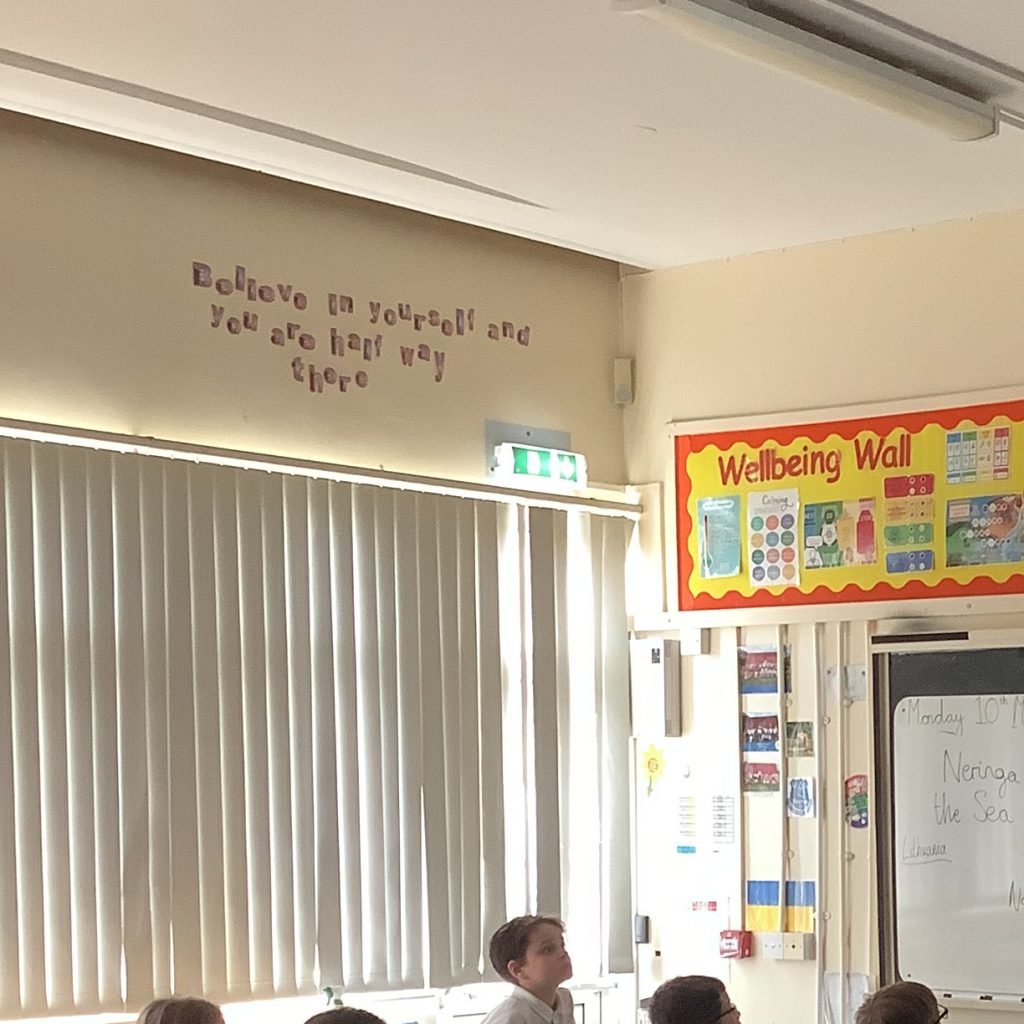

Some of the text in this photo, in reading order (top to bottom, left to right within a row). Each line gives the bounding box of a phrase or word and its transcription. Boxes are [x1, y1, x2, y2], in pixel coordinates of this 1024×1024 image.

[192, 260, 531, 346] Believe in yourself and
[211, 303, 446, 382] you are half way
[291, 356, 369, 393] there
[718, 433, 911, 486] Wellbeing Wall
[907, 698, 965, 737] Monday
[943, 749, 1020, 799] Neringa
[934, 792, 962, 825] the
[973, 789, 1015, 823] Sea
